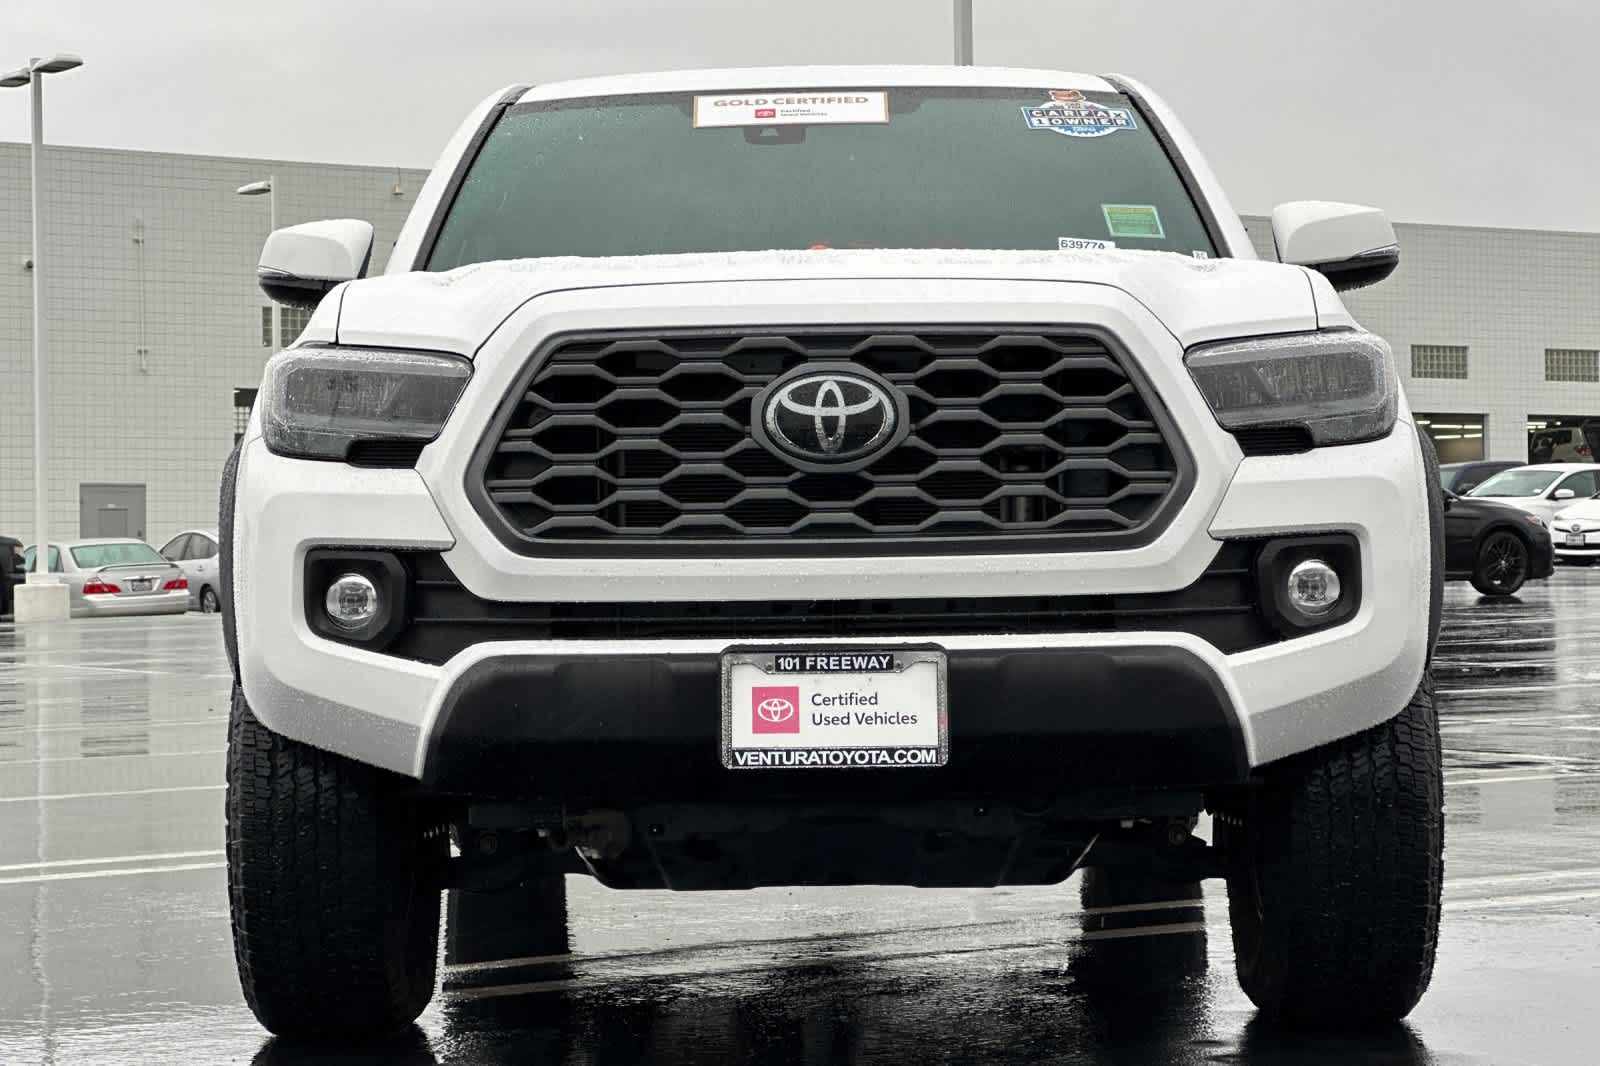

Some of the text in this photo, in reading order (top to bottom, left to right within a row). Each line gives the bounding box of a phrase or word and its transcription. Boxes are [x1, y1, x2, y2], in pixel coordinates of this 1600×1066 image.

[713, 96, 869, 107] GOLD CERTIFIED
[1031, 109, 1127, 118] CARFAX
[777, 655, 890, 670] 101 FREEWAY
[811, 691, 879, 706] Certified
[812, 711, 918, 726] Used Vehicles
[734, 749, 937, 766] VENTURATOYOTA.COM
